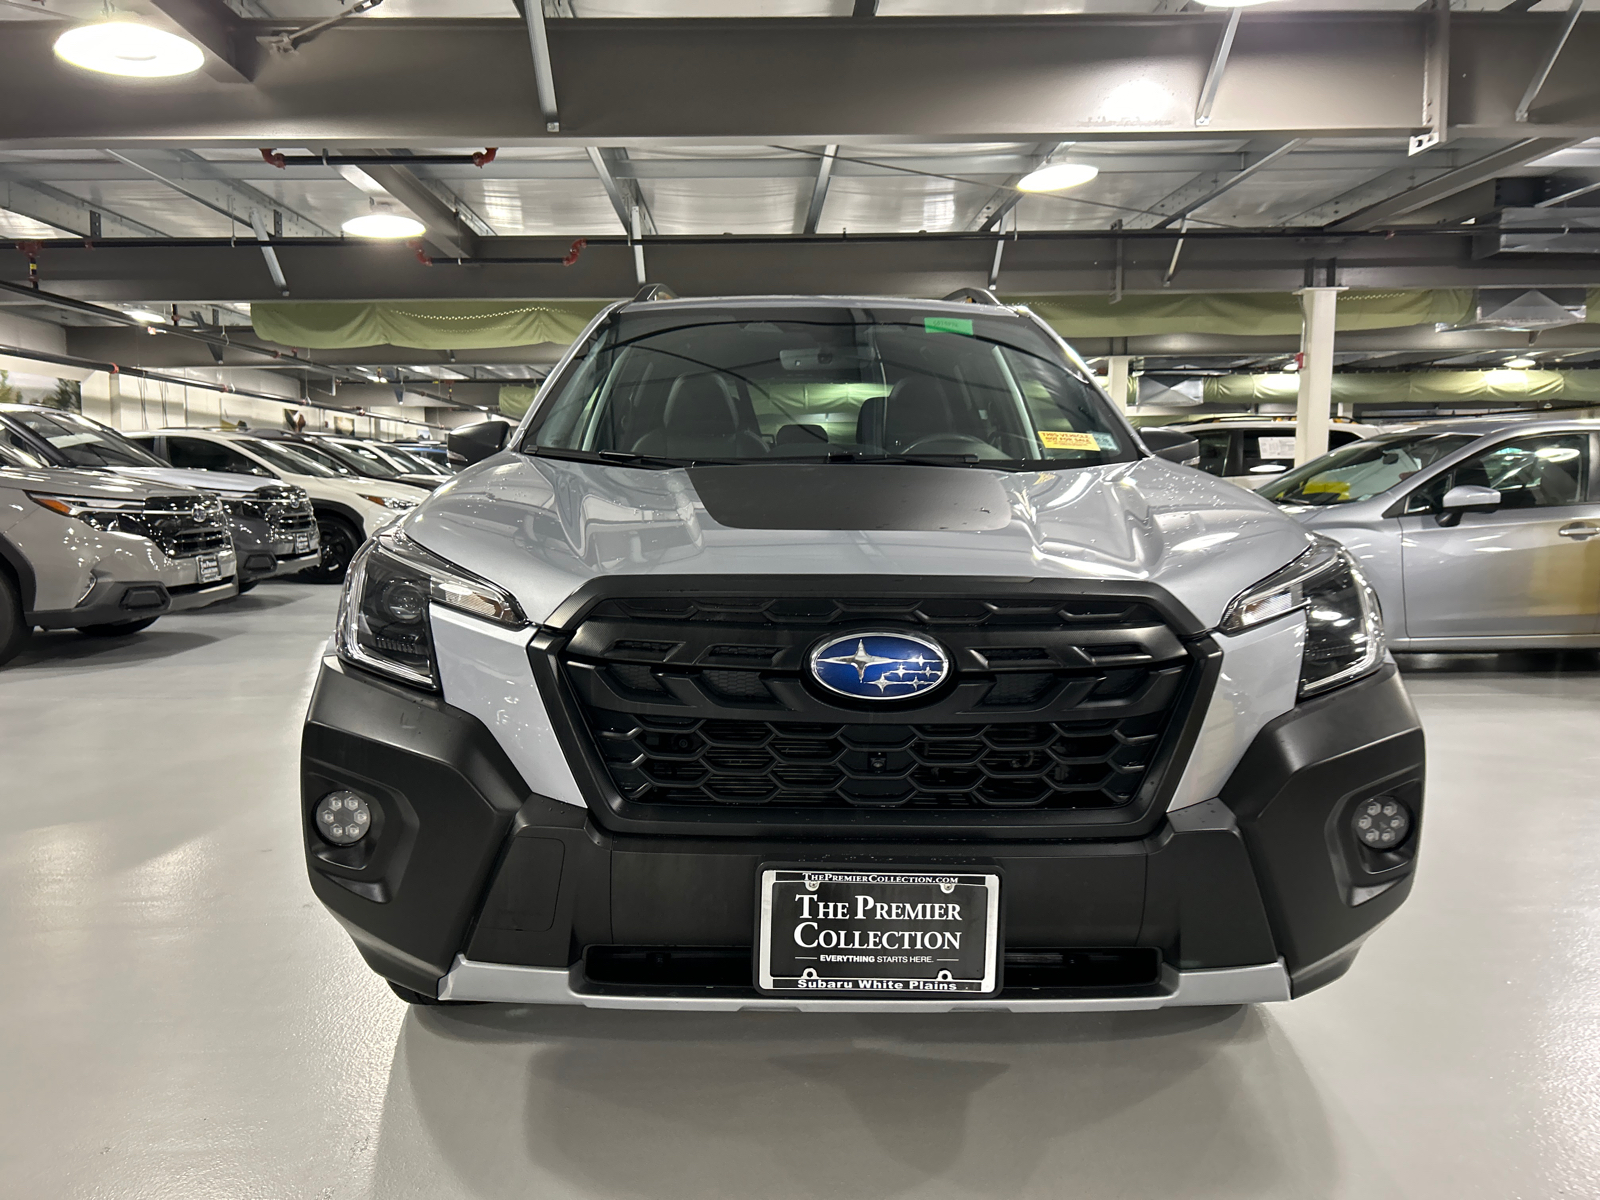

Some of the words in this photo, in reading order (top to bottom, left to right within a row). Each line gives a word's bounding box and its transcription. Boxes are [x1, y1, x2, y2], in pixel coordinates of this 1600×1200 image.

[795, 894, 849, 920] THE
[854, 895, 962, 921] PREMIER
[793, 921, 962, 950] COLLECTION
[820, 955, 875, 963] EVERYTHING
[797, 979, 853, 989] Subaru
[857, 980, 904, 990] White
[909, 981, 957, 991] Plains
